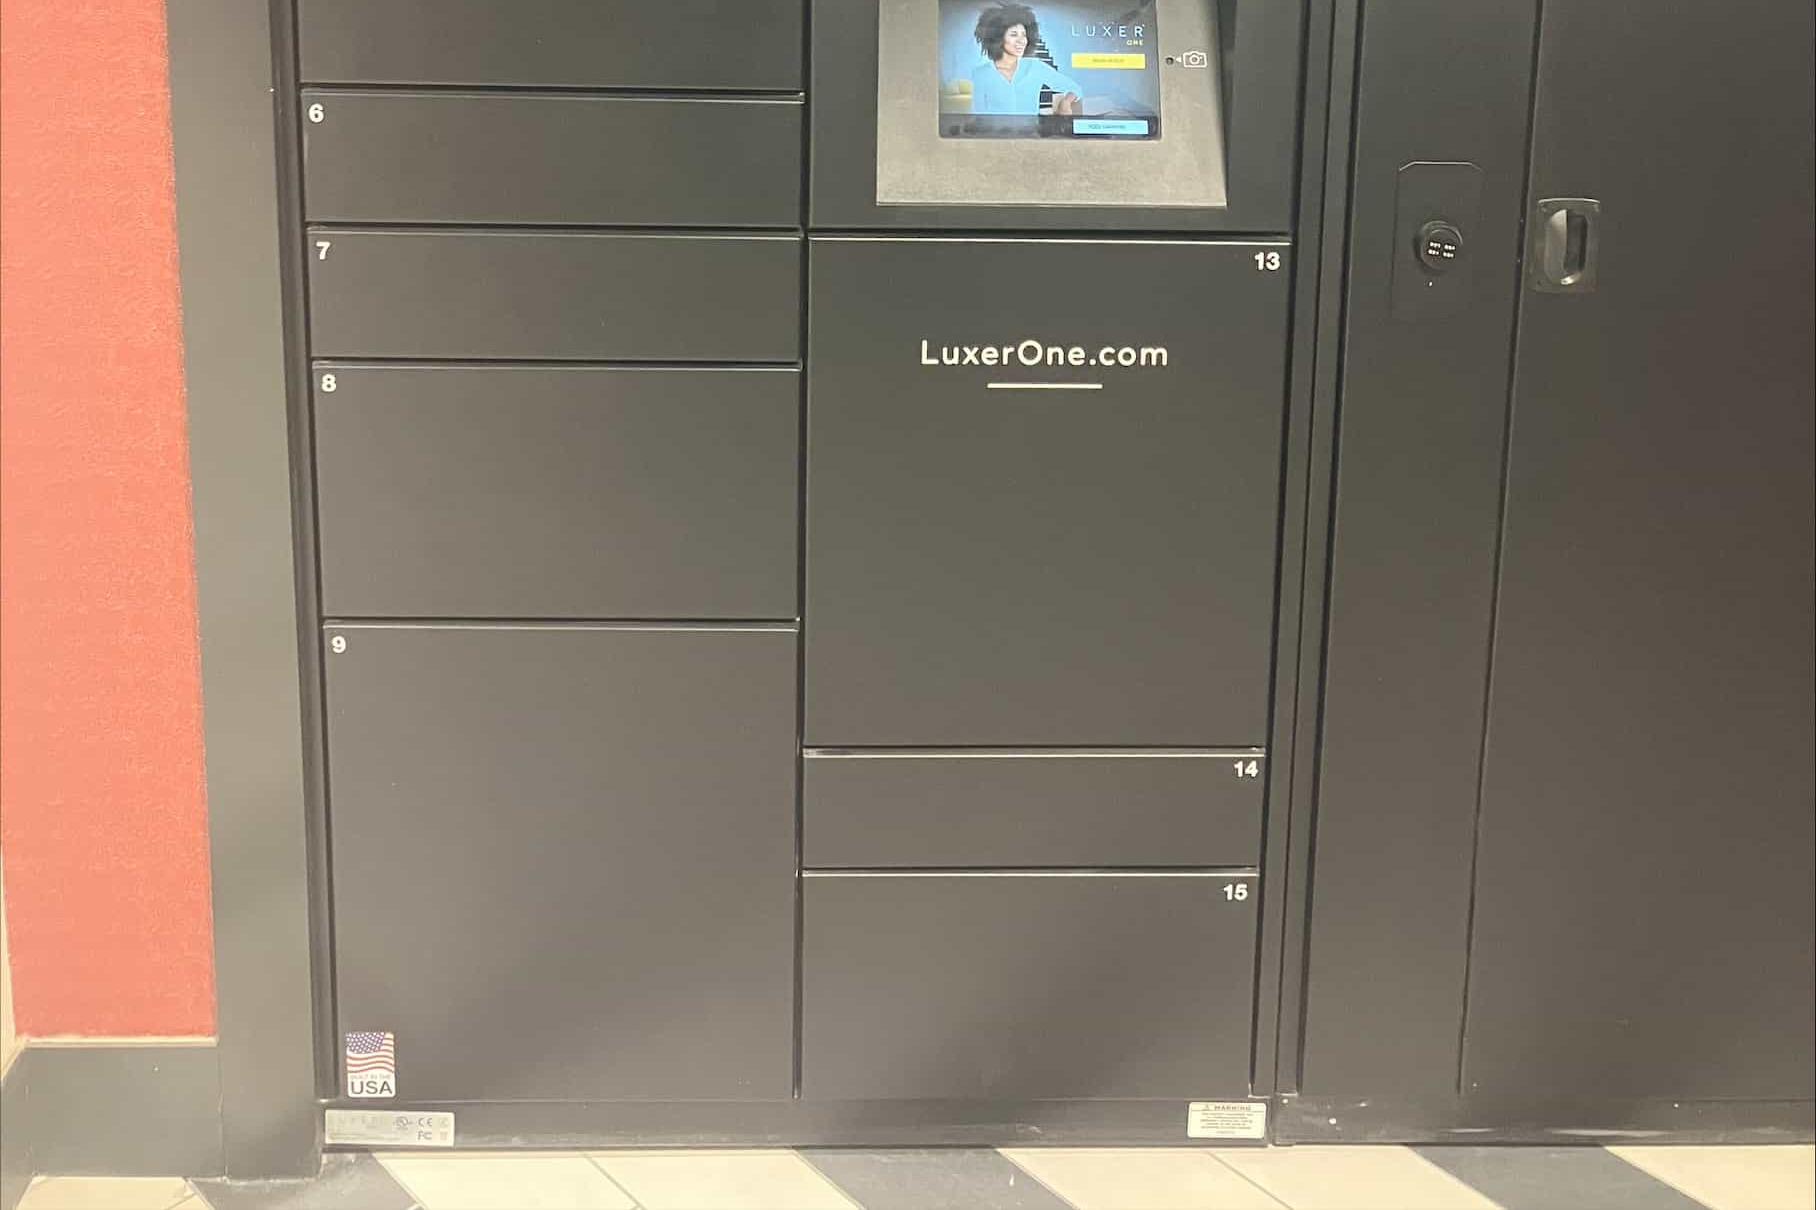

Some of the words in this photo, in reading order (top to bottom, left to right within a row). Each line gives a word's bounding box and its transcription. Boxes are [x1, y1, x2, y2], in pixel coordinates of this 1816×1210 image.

[1071, 25, 1144, 38] LUXER
[308, 103, 324, 123] 6
[316, 241, 331, 260] 7
[1254, 251, 1281, 271] 13
[920, 339, 1168, 367] LuxerOne.com
[321, 373, 337, 392] 8
[331, 635, 347, 654] 9
[1233, 760, 1259, 778] 14
[1223, 883, 1248, 901] 15
[350, 1080, 393, 1095] USA
